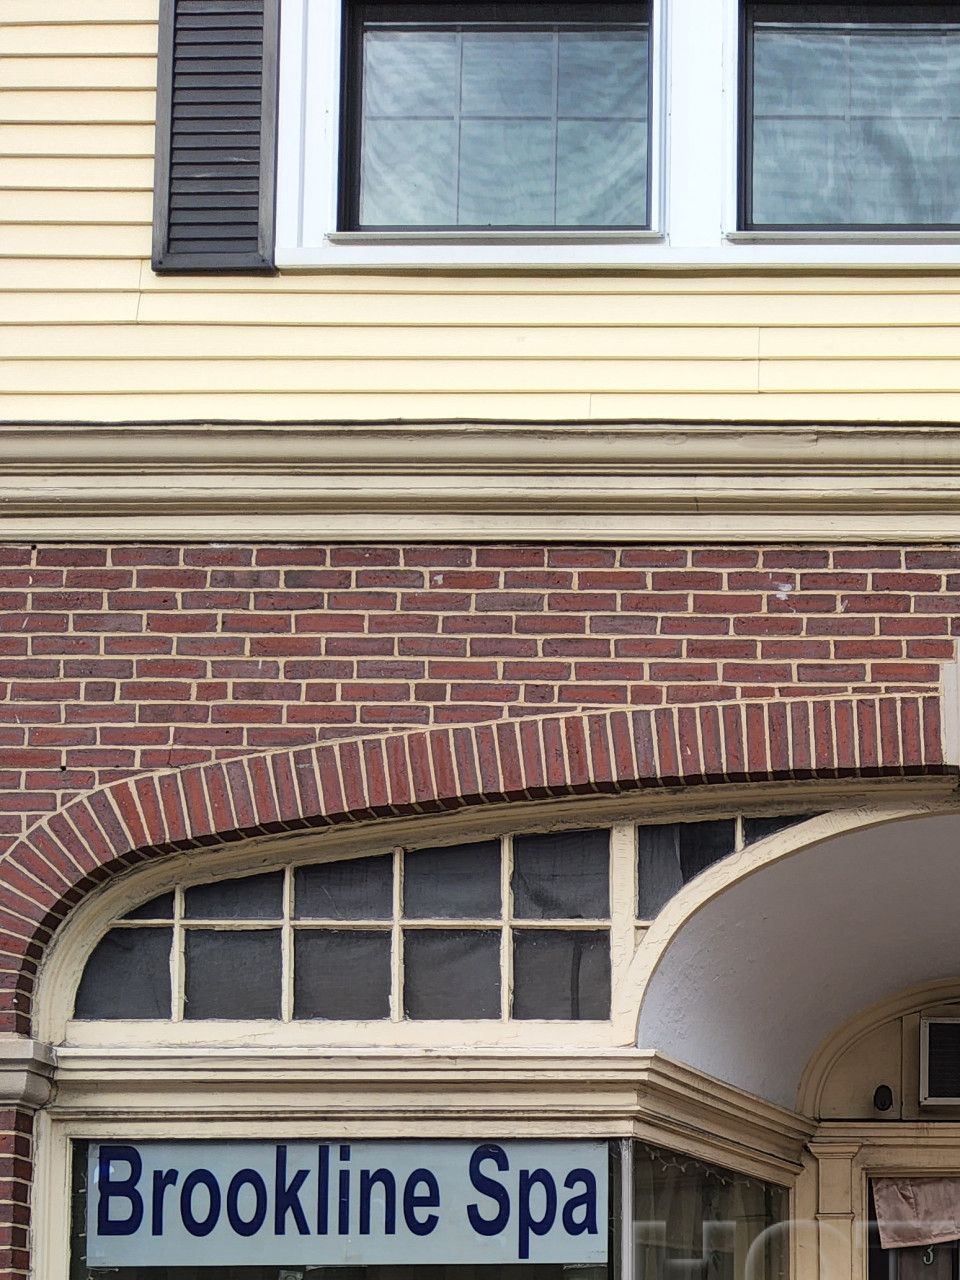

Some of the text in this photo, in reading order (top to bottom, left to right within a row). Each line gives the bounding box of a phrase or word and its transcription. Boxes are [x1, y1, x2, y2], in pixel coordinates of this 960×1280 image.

[96, 1144, 599, 1260] Brookline Spa
[922, 1244, 935, 1265] 3
